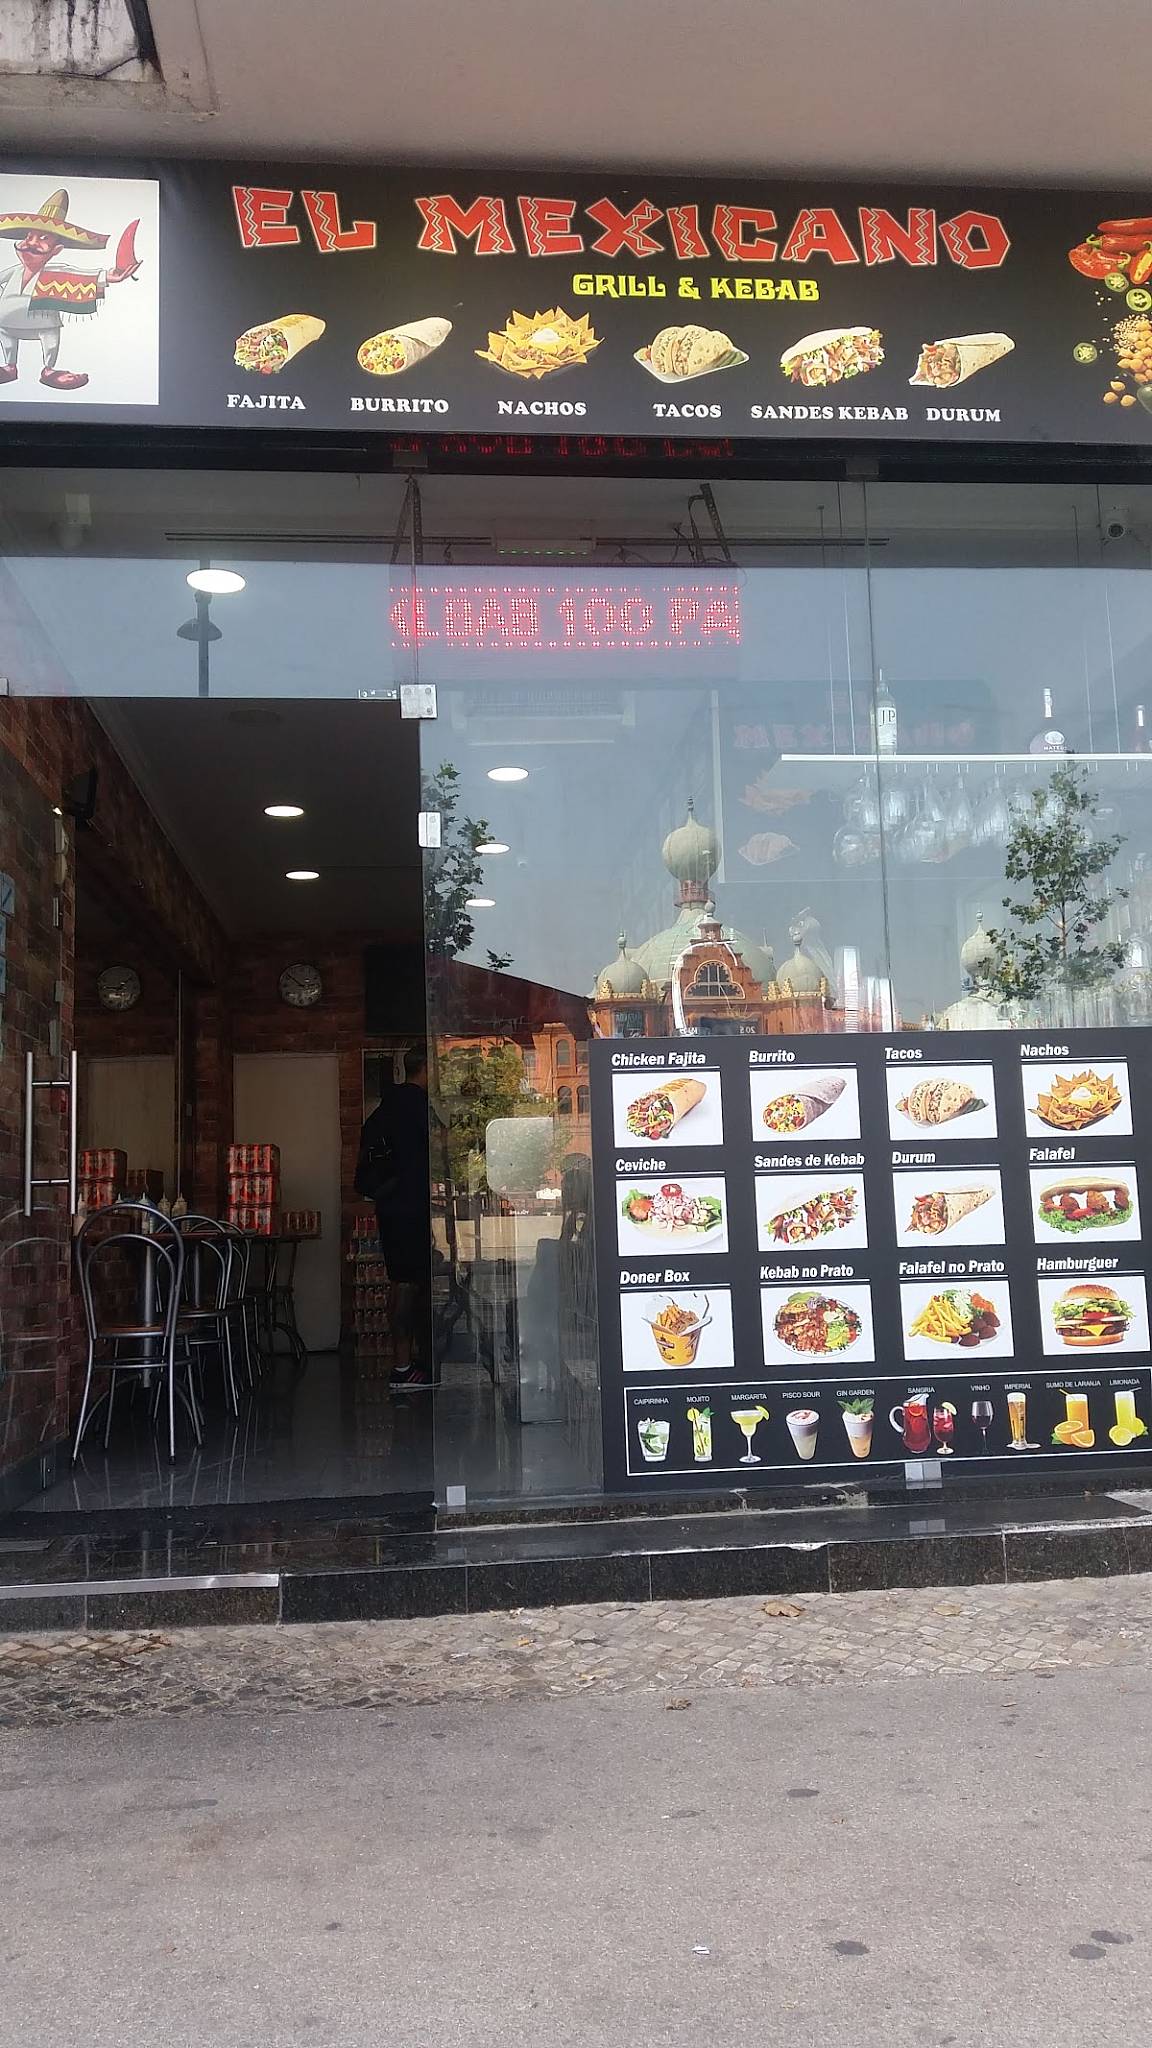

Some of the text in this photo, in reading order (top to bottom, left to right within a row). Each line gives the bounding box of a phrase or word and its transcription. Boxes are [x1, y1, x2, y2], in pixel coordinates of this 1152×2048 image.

[234, 187, 1012, 271] EL MEXICANO
[572, 273, 820, 302] GRILL & KEBAB
[226, 394, 307, 410] FAJITA
[350, 397, 449, 414] BURRITO
[497, 400, 587, 416] NACHOS
[652, 403, 722, 419] TACOS
[750, 405, 909, 421] SANDES KEBAB
[925, 407, 1001, 422] DURUM
[557, 597, 653, 637] 100
[748, 1049, 796, 1063] Burrito
[884, 1047, 923, 1060] Tacos
[1020, 1043, 1070, 1057] Nachos
[611, 1051, 706, 1067] Chicken Fajita
[753, 1152, 865, 1168] Sandes de Kebab
[891, 1151, 936, 1165] Durum
[1029, 1146, 1076, 1161] Falafel
[615, 1157, 667, 1172] Ceviche
[898, 1259, 1005, 1275] Falafel no Prato
[1036, 1256, 1119, 1272] Hamburguer
[619, 1269, 690, 1285] Doner Box
[759, 1264, 854, 1280] Kebab no Prato
[970, 1384, 991, 1392] VINHO
[1045, 1381, 1065, 1389] SUMO
[1073, 1380, 1102, 1388] LARANJA
[1109, 1378, 1140, 1386] LIMONADA
[730, 1393, 768, 1401] MARGARITA
[781, 1390, 821, 1399] PISCO SOUR
[836, 1388, 875, 1397] GIN GARDEN
[907, 1386, 936, 1395] SANGRIA
[633, 1397, 670, 1406] CAIPIRINHA
[686, 1395, 710, 1403] MOJITO
